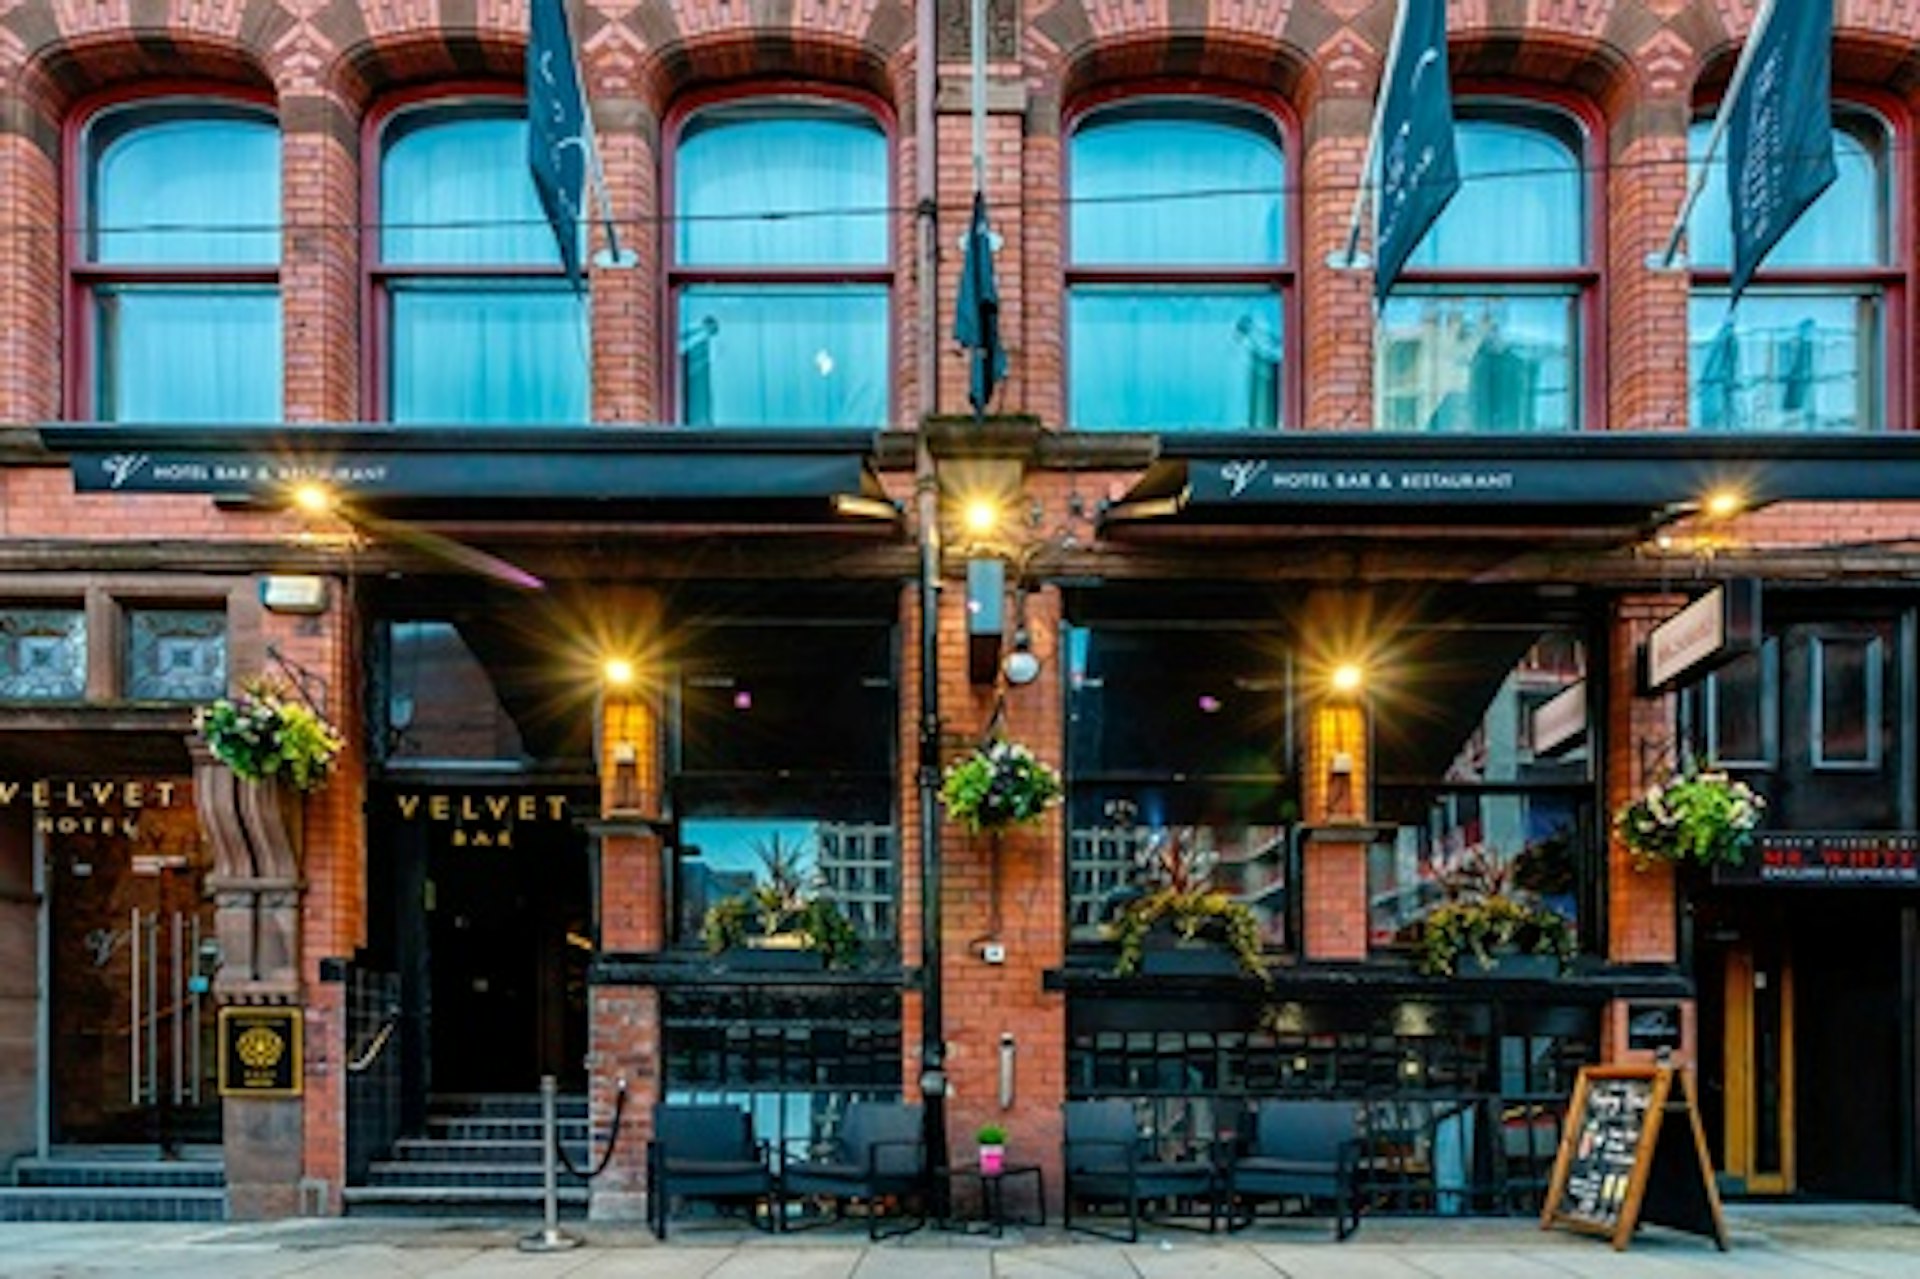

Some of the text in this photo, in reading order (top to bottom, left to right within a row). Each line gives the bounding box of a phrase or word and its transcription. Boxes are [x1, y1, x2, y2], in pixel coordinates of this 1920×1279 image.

[153, 464, 208, 480] HOTEL
[214, 464, 249, 480] BAR
[256, 464, 270, 480] &
[1273, 472, 1513, 489] HOTEL BAR & RESTAURANT
[0, 781, 175, 808] VELVET
[398, 795, 567, 820] VELVET
[38, 816, 138, 840] HOTEL
[453, 829, 512, 847] BAR
